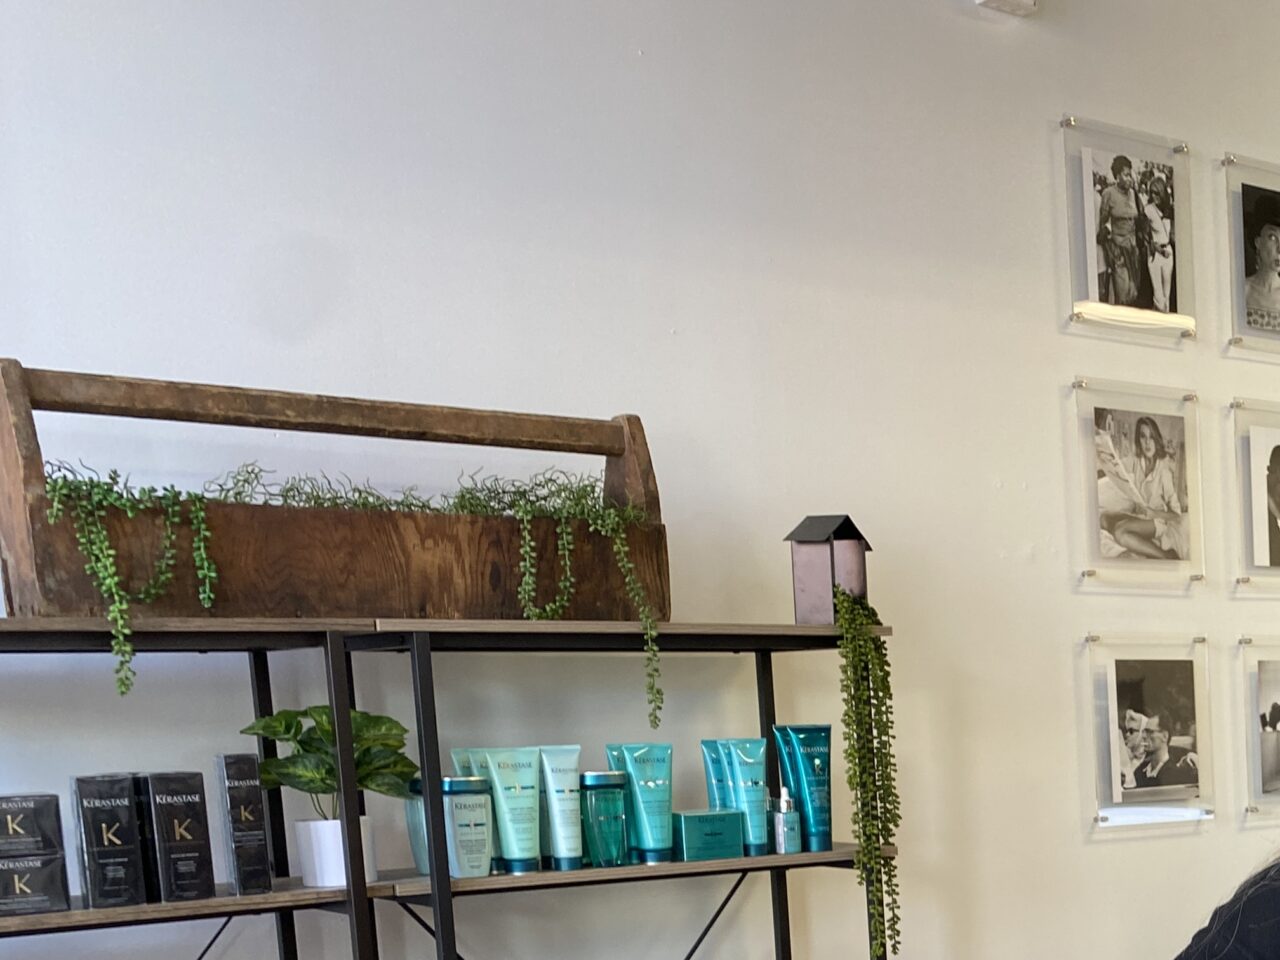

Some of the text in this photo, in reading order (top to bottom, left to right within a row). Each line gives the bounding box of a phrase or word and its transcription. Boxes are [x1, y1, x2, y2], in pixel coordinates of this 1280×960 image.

[241, 804, 254, 821] K
[7, 814, 24, 834] K
[102, 822, 122, 846] K
[174, 819, 192, 840] K
[14, 873, 31, 894] K
